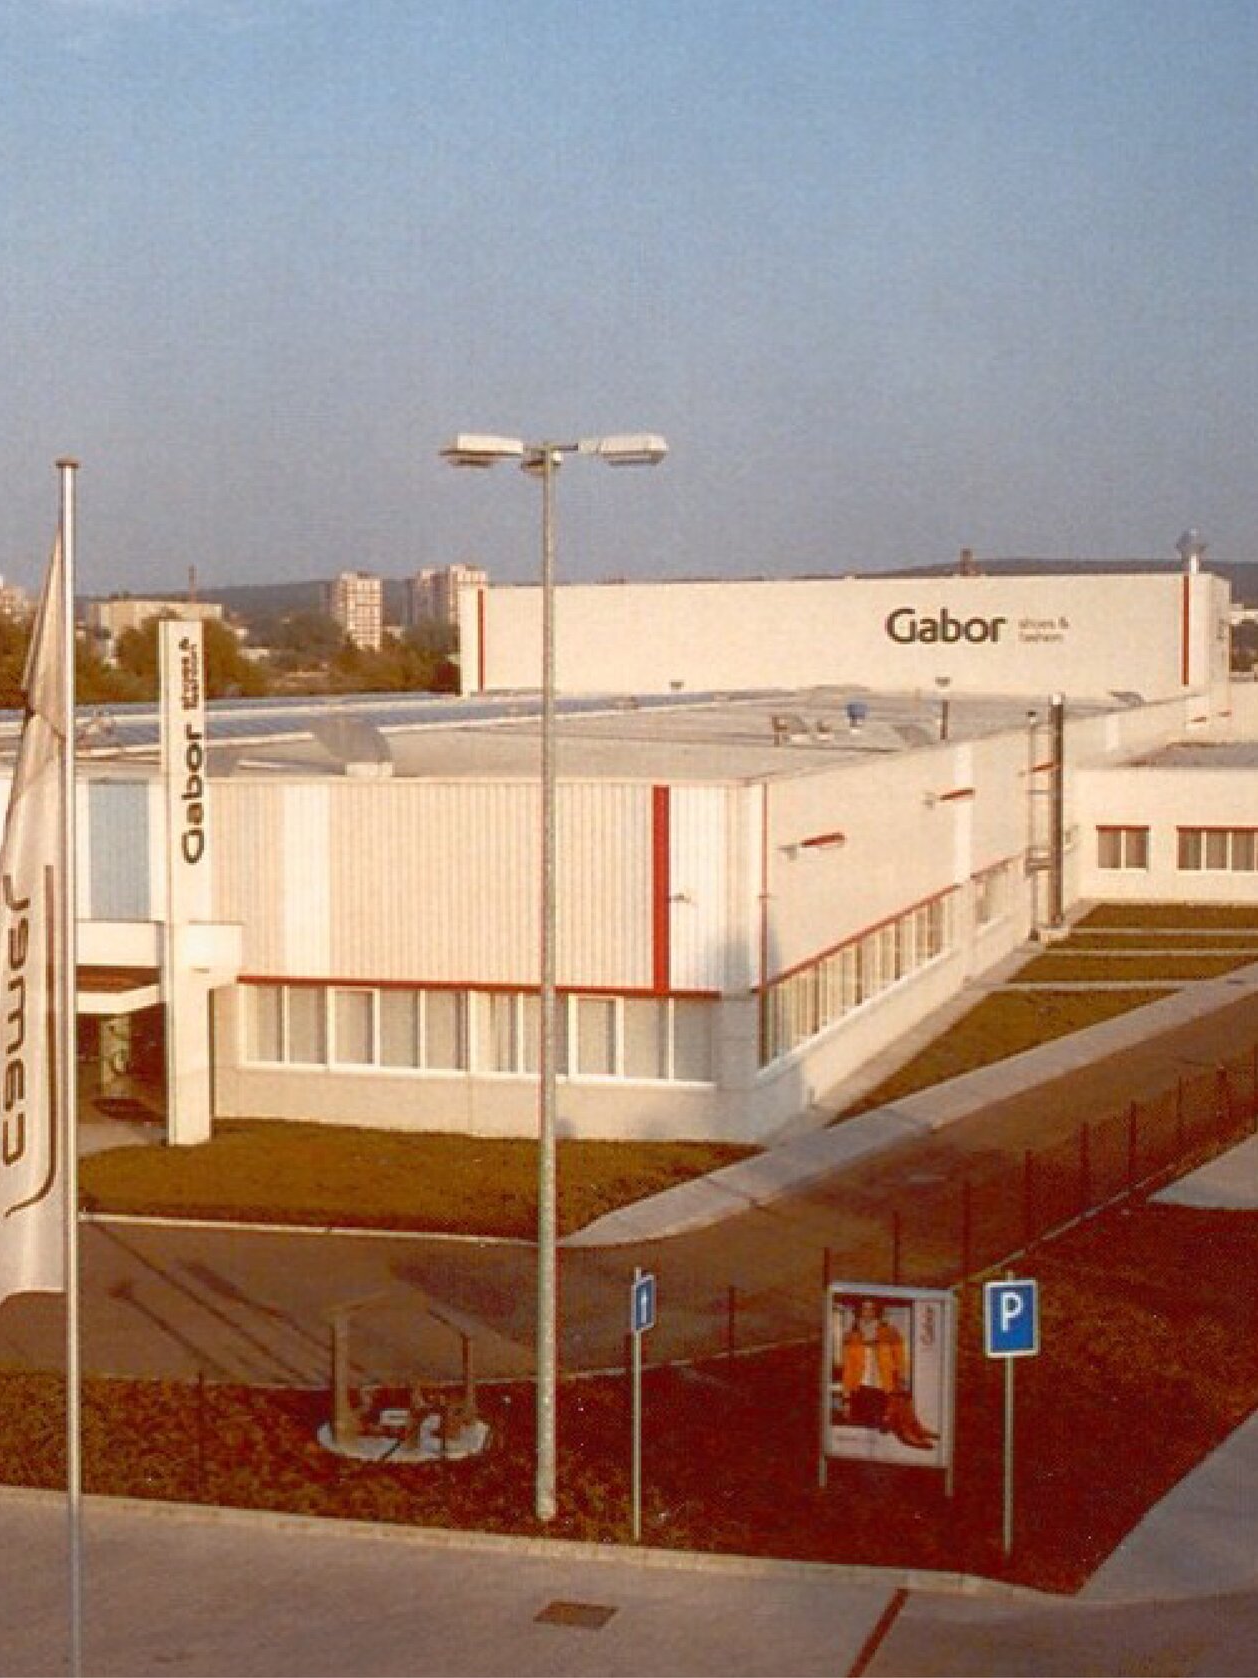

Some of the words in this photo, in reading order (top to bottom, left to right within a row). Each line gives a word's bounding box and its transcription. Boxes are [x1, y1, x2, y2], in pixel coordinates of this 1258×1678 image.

[886, 607, 1007, 643] Gabor
[181, 724, 204, 865] Gabor
[1001, 1291, 1023, 1332] P
